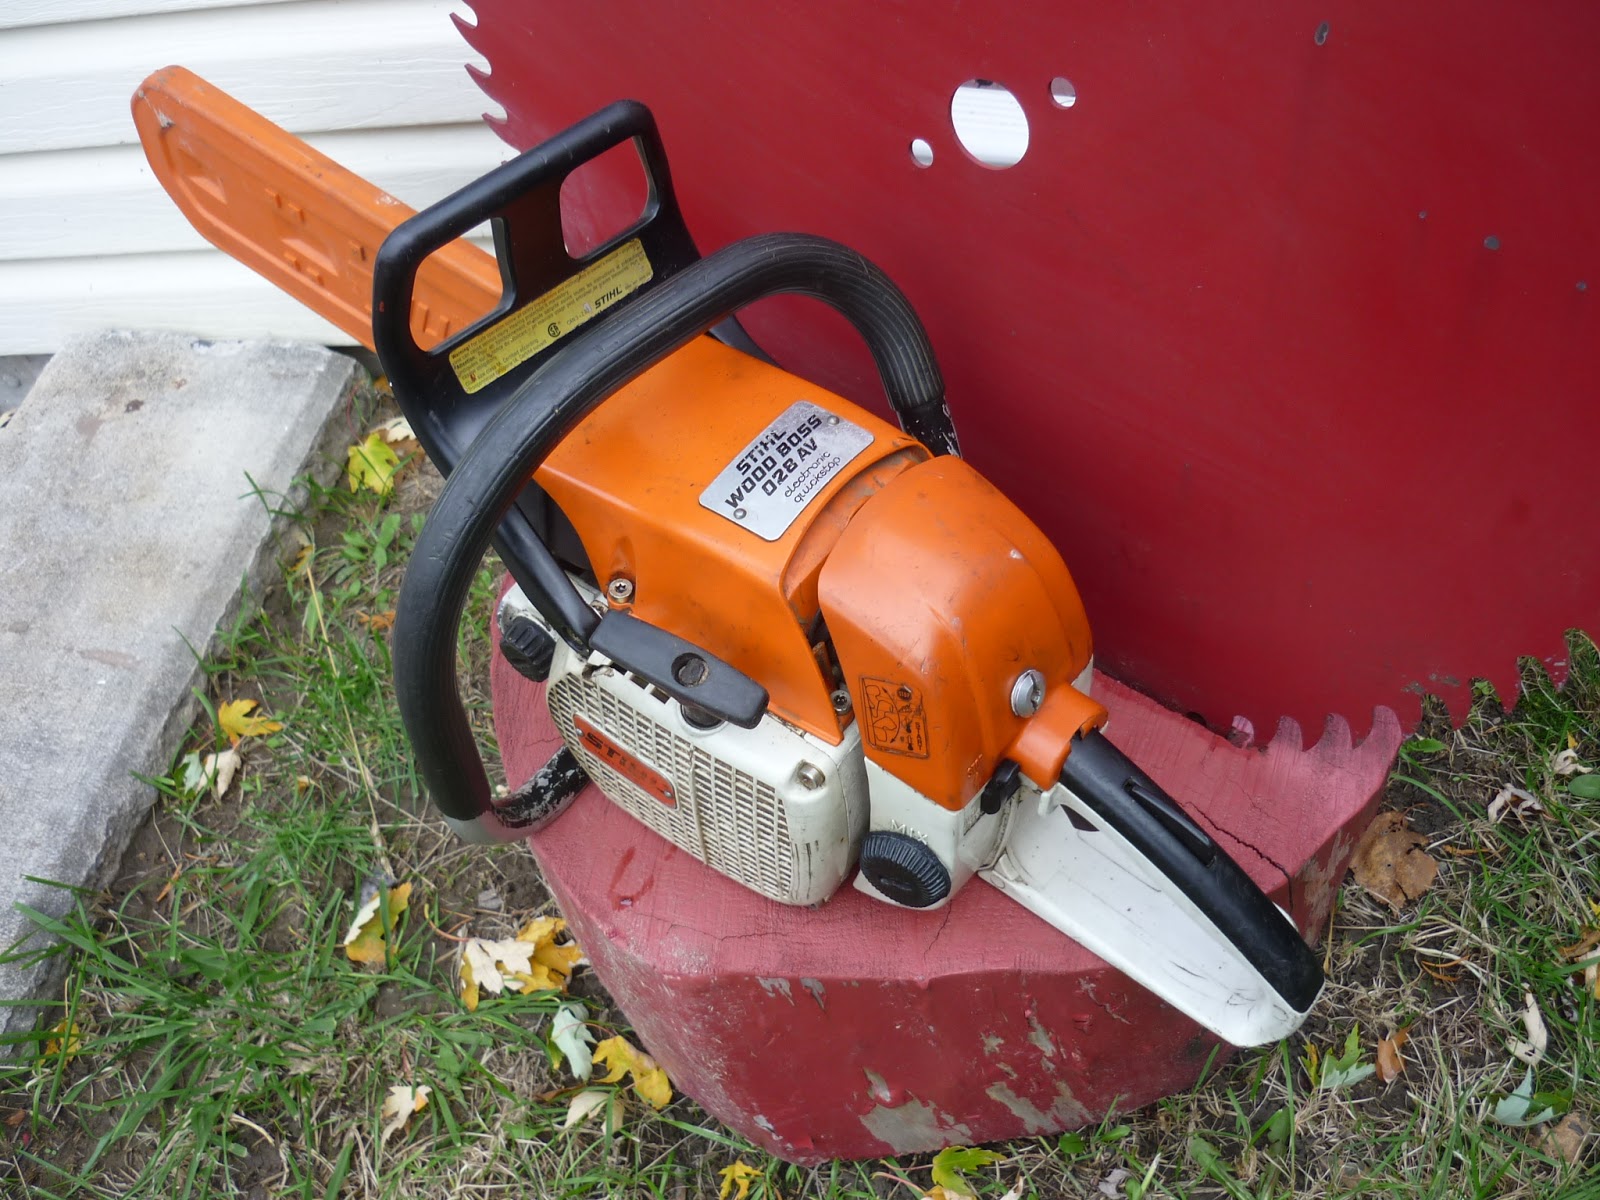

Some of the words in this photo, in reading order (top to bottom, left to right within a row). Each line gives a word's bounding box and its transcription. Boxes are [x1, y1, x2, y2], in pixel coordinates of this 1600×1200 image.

[594, 287, 622, 310] STIHL
[724, 456, 778, 508] WOOD
[776, 414, 822, 457] BOSS
[736, 430, 787, 476] STIHL
[762, 458, 798, 496] 028
[799, 437, 818, 463] AV
[784, 450, 831, 498] electronic
[794, 456, 840, 504] quickstop
[891, 819, 928, 845] MIX
